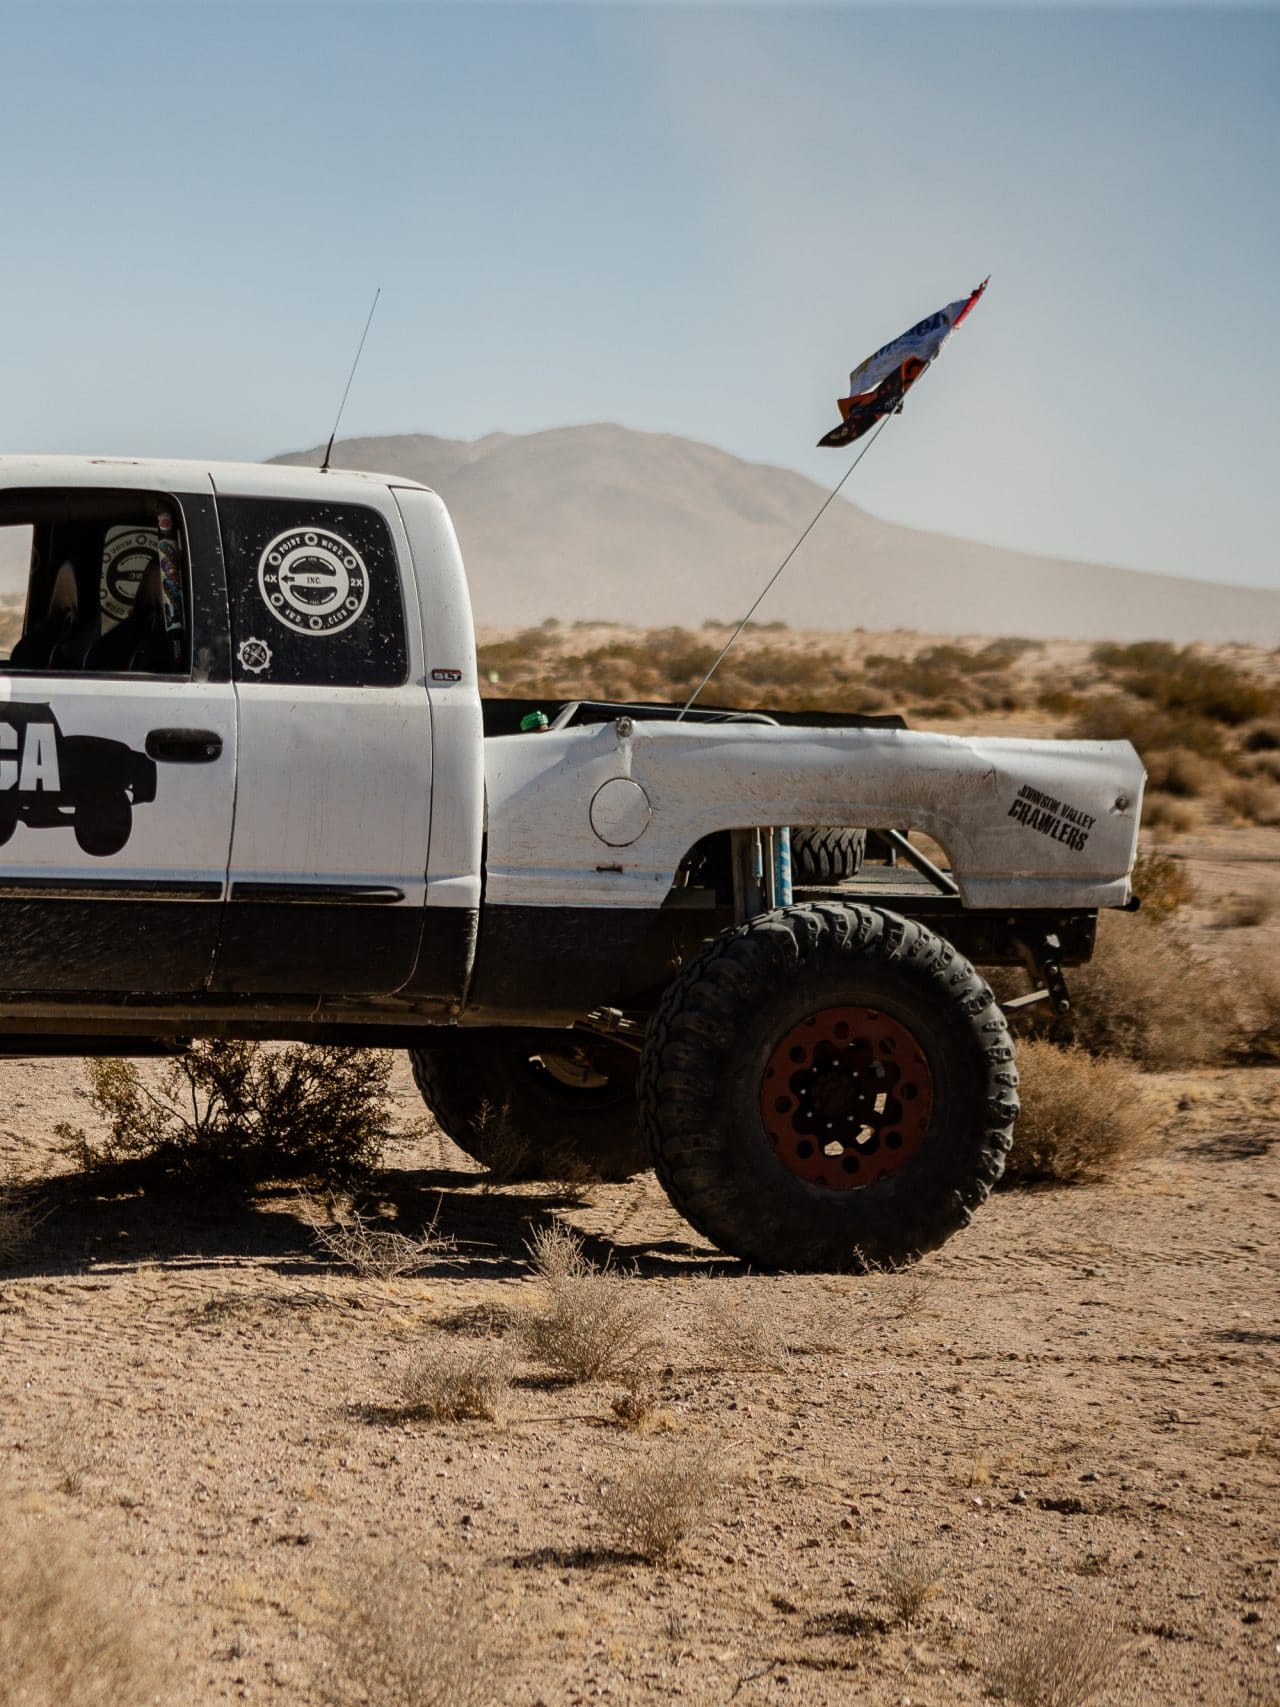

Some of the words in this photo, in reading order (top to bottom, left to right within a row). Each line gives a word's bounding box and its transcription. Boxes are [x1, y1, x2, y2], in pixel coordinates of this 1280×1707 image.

[264, 574, 278, 583] 4X
[350, 578, 363, 587] 2X
[1017, 784, 1061, 814] JOHNSON
[1060, 804, 1096, 830] VALLEY
[1007, 799, 1089, 852] CRAWLERS
